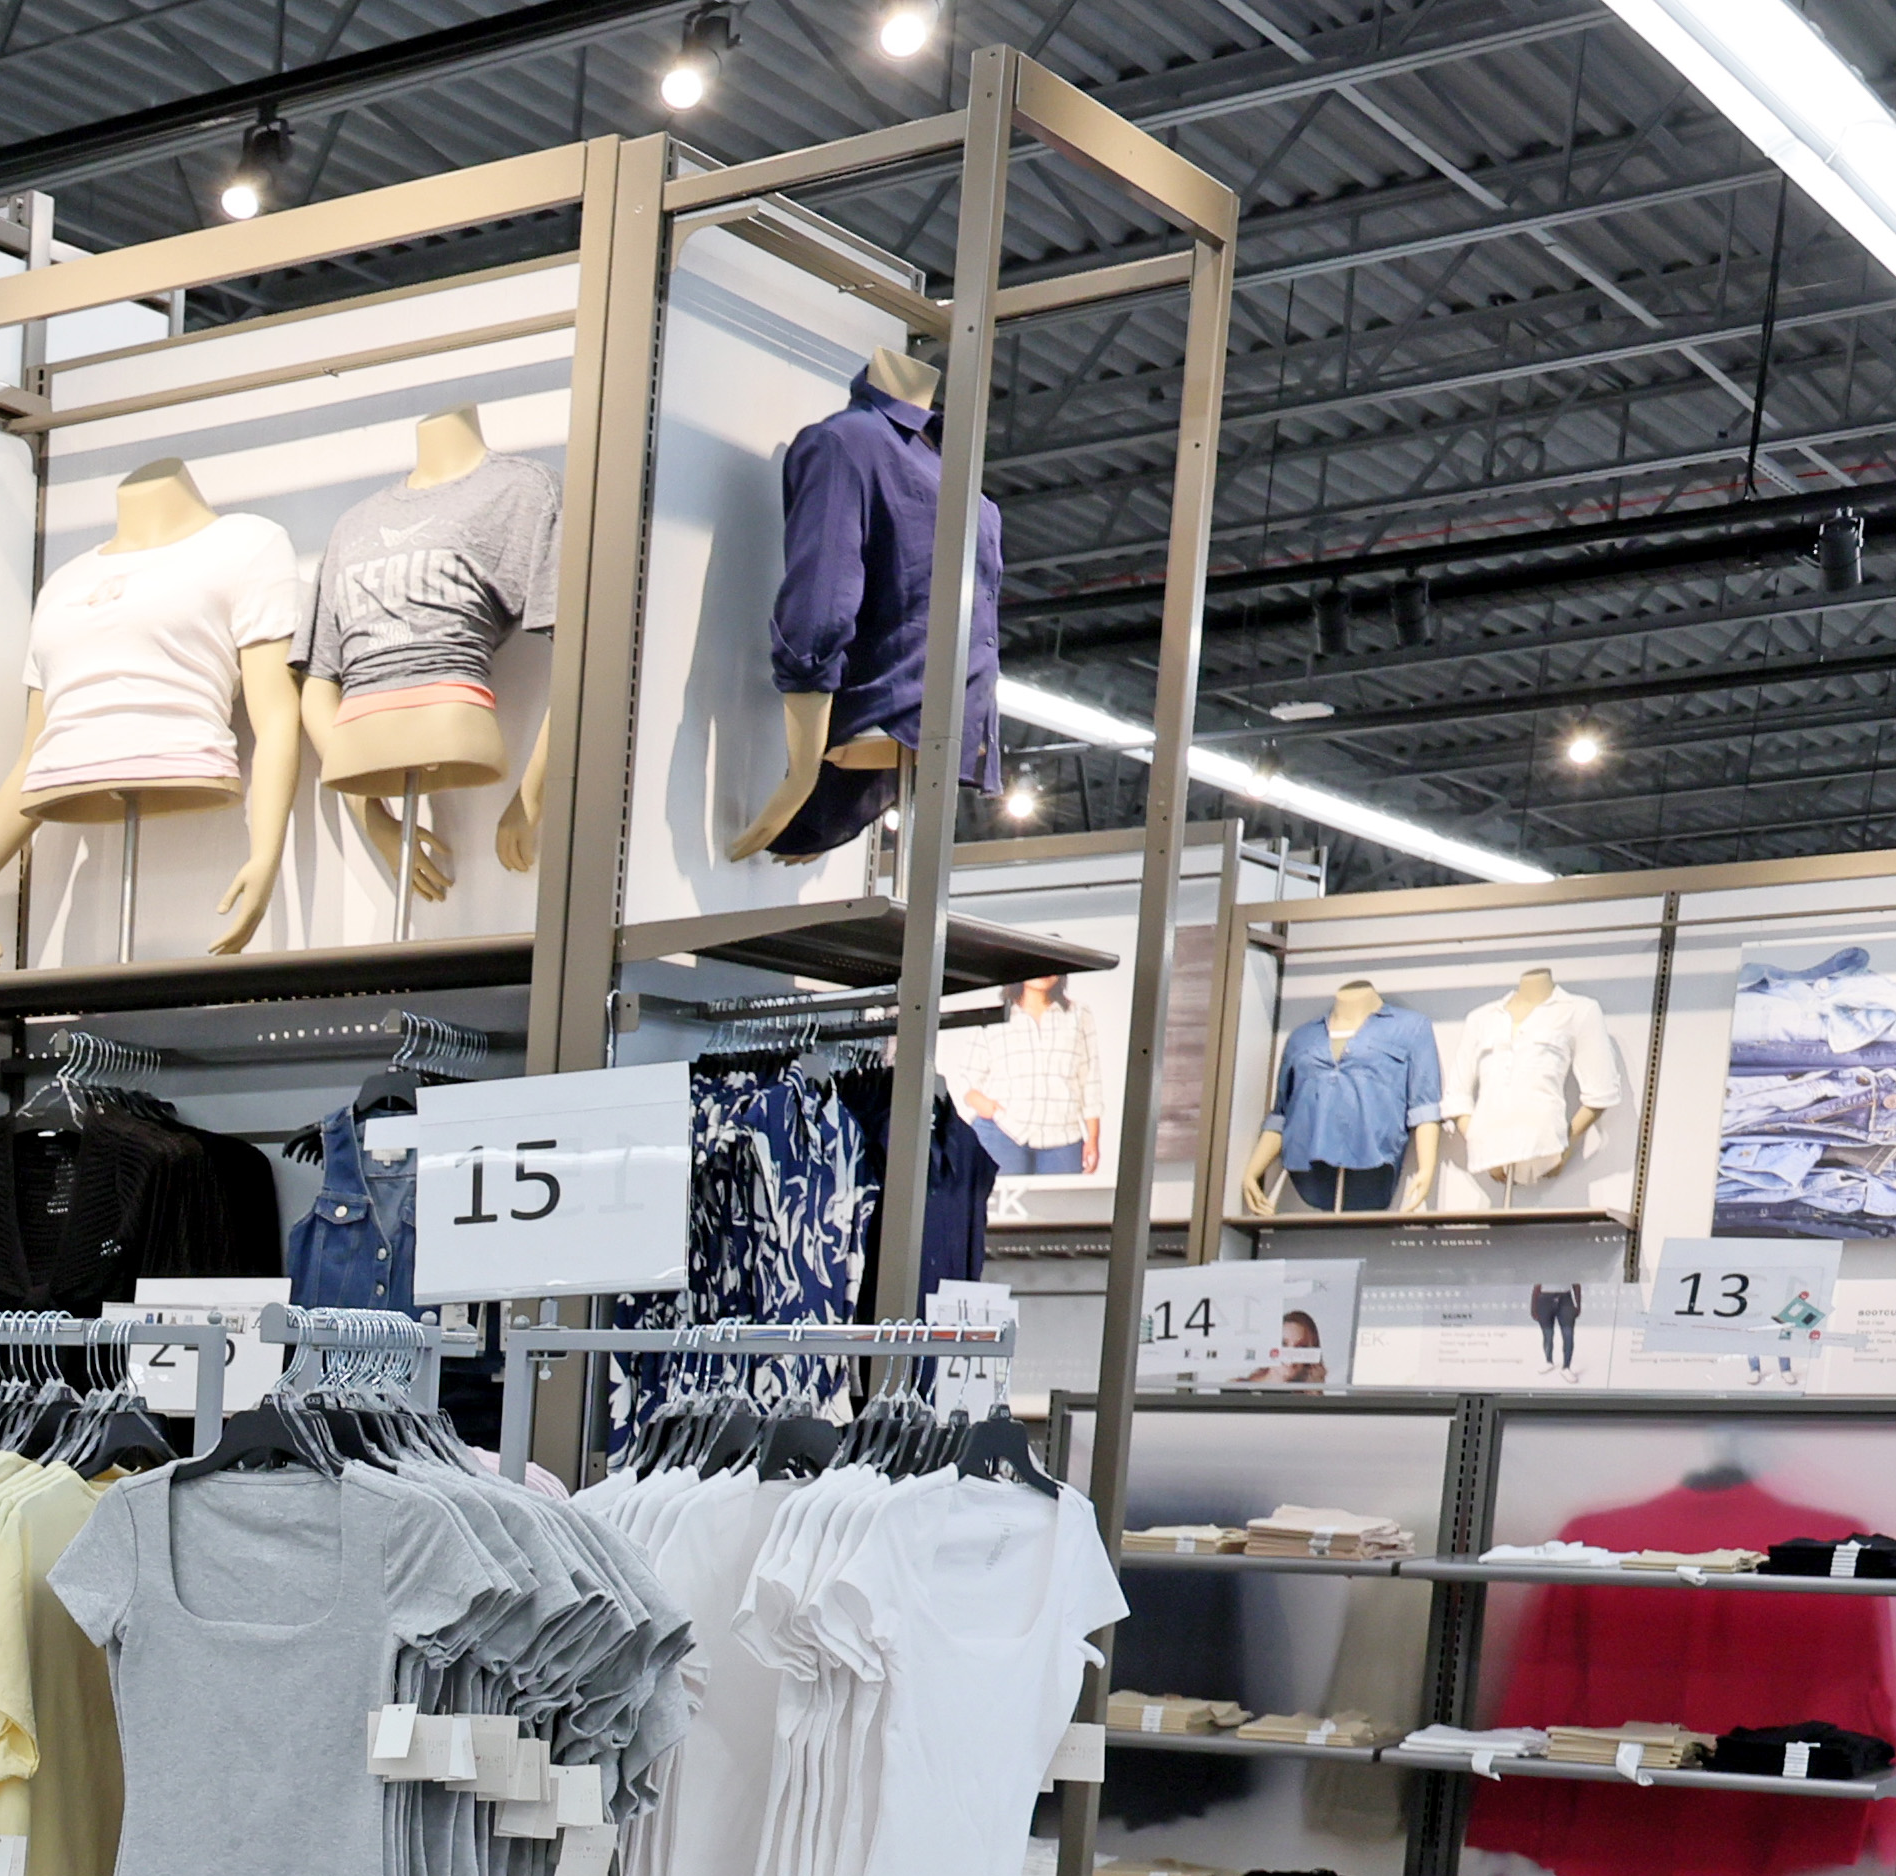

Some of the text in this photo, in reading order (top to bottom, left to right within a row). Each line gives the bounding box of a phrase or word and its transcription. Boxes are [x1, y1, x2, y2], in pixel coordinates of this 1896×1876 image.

[454, 1139, 560, 1225] 15
[1674, 1272, 1750, 1318] 13
[1155, 1297, 1216, 1341] 14
